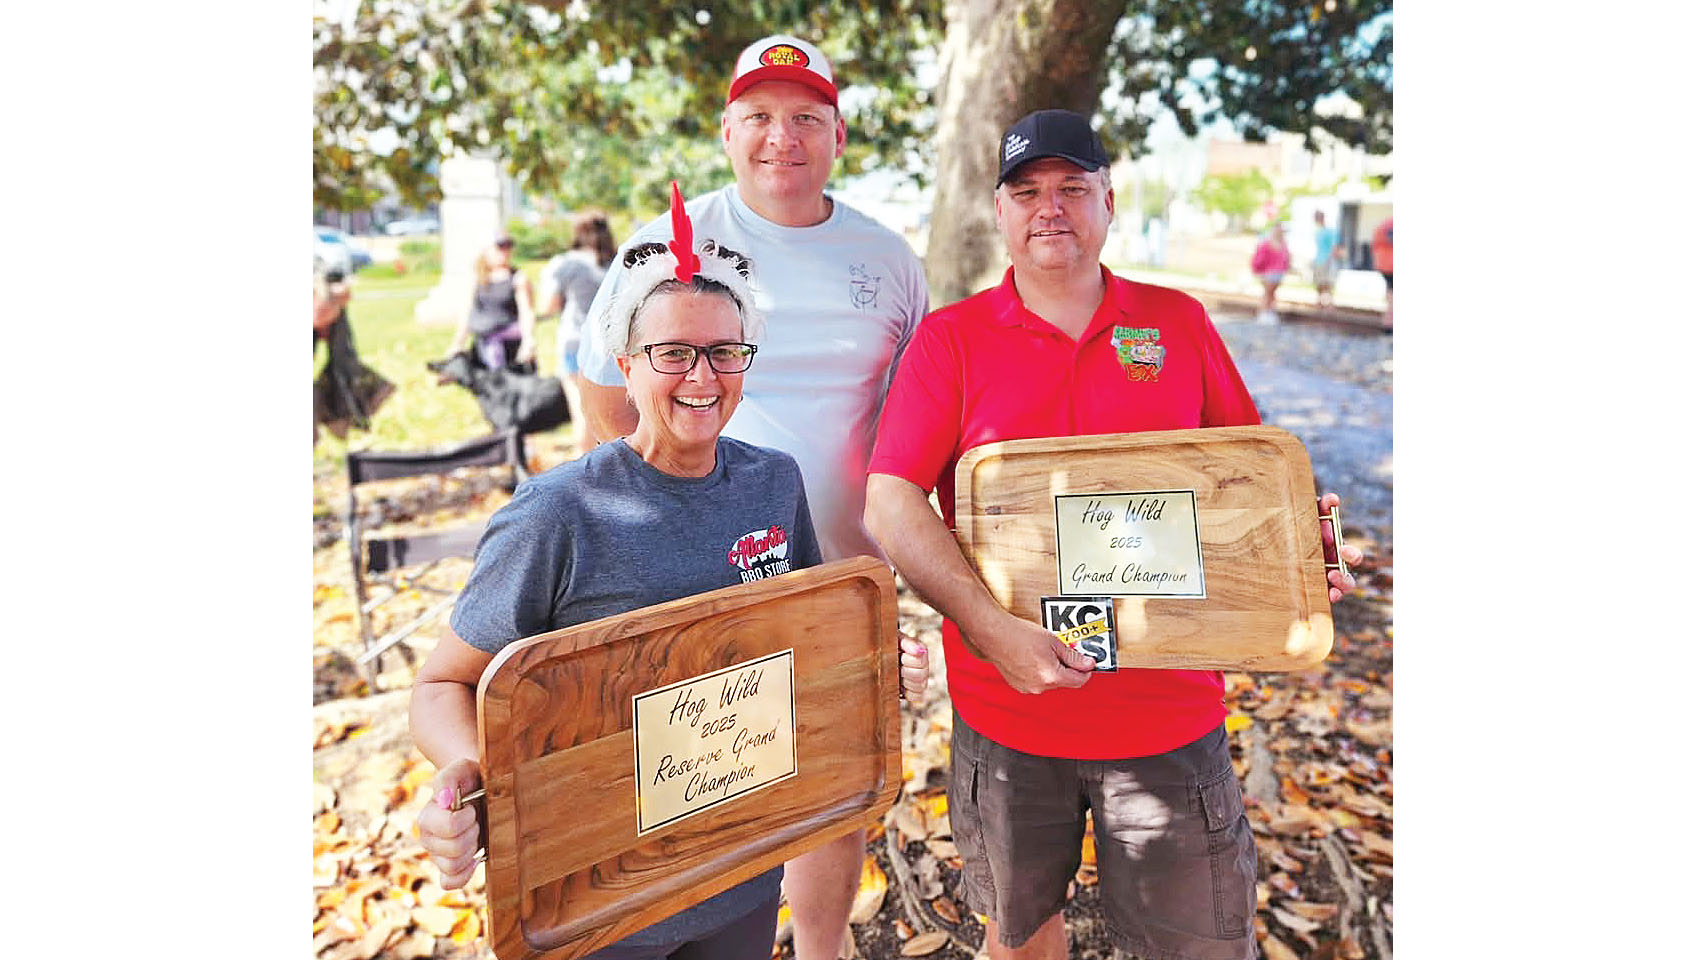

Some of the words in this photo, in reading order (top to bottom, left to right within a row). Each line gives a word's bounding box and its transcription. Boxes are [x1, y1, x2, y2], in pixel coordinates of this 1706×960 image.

[768, 52, 801, 62] ROYAL
[1082, 500, 1115, 531] Hog
[1125, 498, 1167, 524] Wild
[728, 525, 787, 570] Atlanta
[1109, 536, 1144, 549] 2025
[1072, 562, 1118, 590] Grand
[1121, 562, 1188, 590] Champion
[1061, 625, 1099, 642] 700+
[668, 688, 709, 728] Hog
[719, 668, 764, 709] Wild
[700, 713, 738, 739] 2025
[653, 749, 724, 786] Reserve
[732, 719, 781, 763] Grand
[684, 762, 756, 802] Champion
